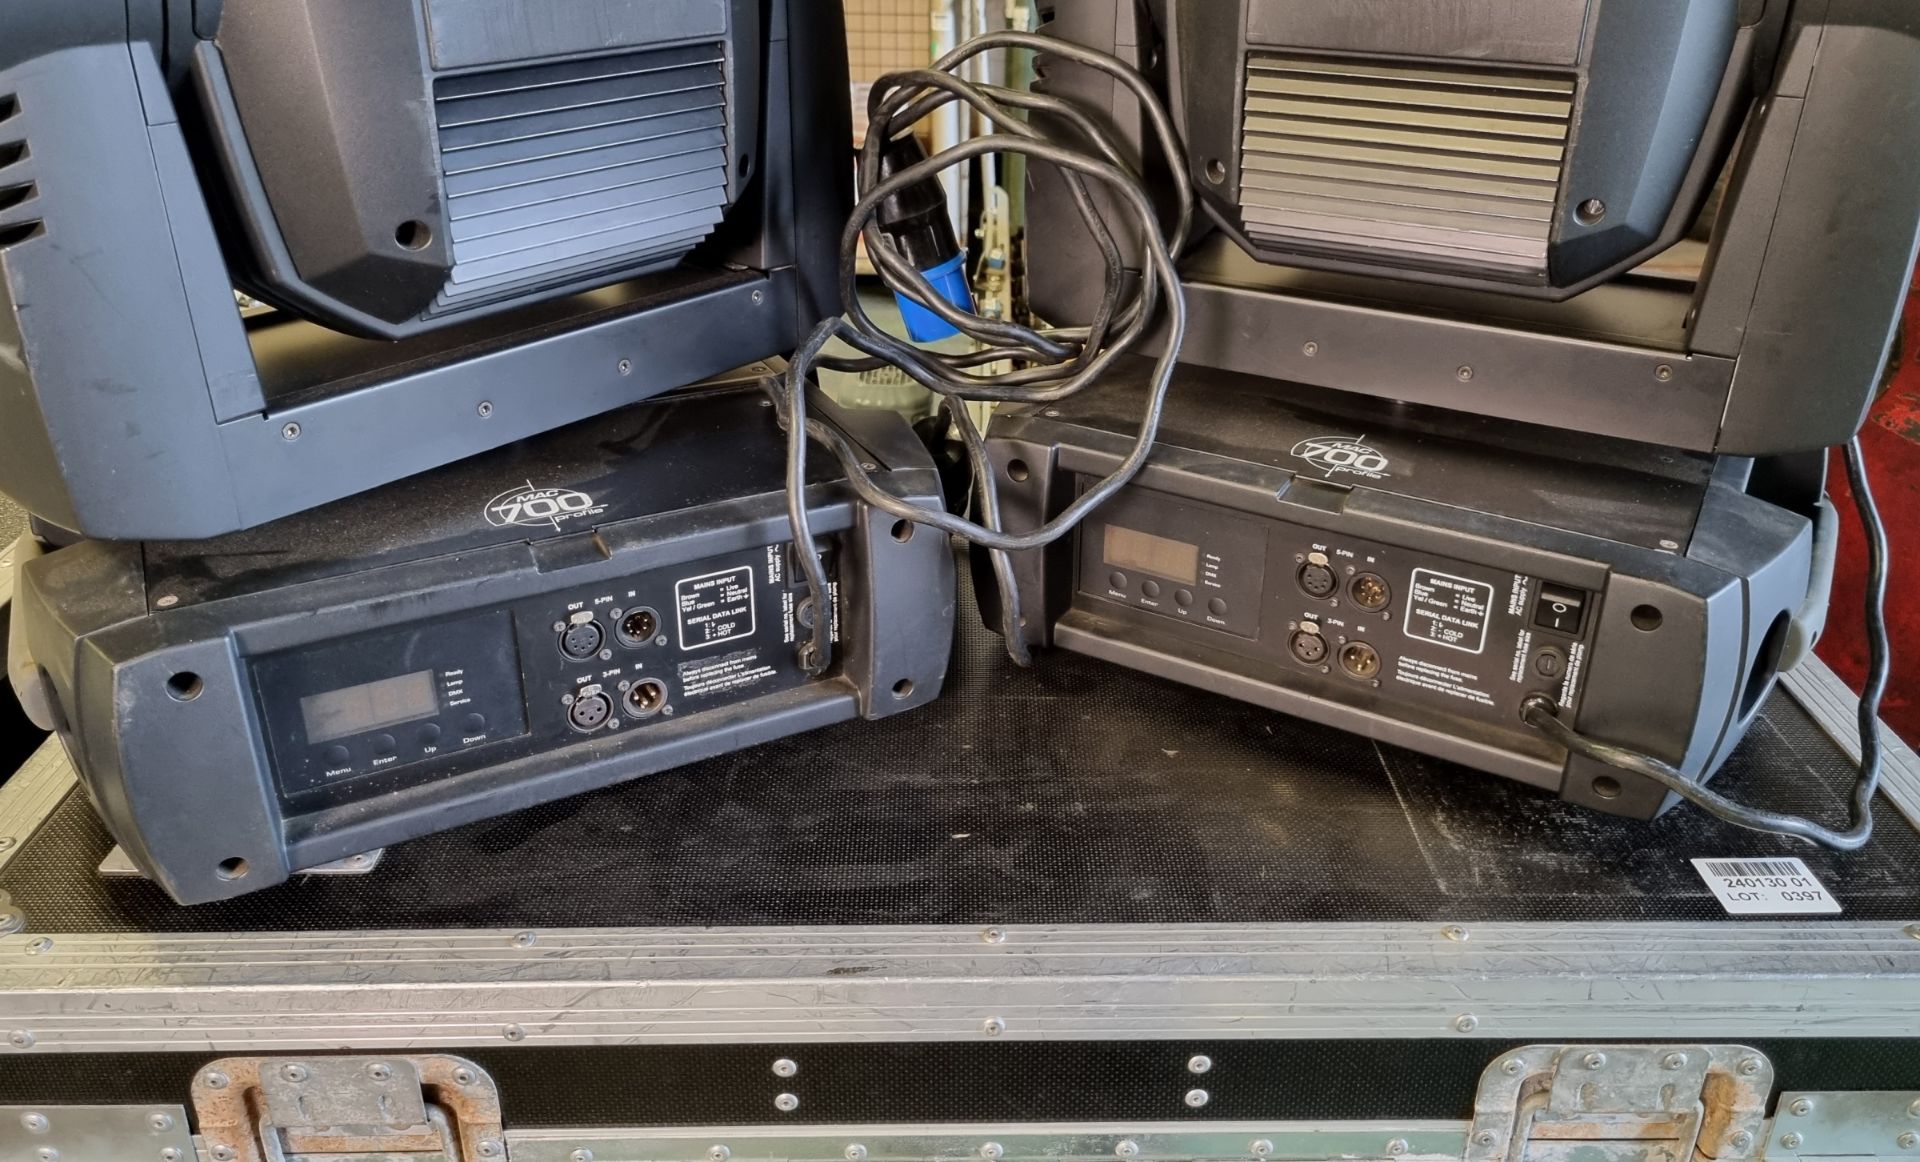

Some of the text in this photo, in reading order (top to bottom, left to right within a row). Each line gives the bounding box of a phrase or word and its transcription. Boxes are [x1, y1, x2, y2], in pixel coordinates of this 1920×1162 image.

[1331, 442, 1373, 454] MAC
[1300, 442, 1388, 471] 700
[1335, 467, 1382, 479] profile
[517, 490, 558, 502] MAC
[491, 492, 593, 523] 700
[554, 508, 604, 522] profile
[1312, 543, 1327, 551] OUT
[1336, 549, 1354, 558] 5-PIN
[693, 575, 736, 590] MAINS INPUT
[775, 573, 781, 582] AC
[1430, 578, 1476, 594] MAINS INPUT
[726, 587, 748, 597] Neutral
[1108, 590, 1126, 599] Menu
[1415, 583, 1435, 592] Brown
[1462, 594, 1476, 602] Live
[1508, 574, 1522, 615] MAINS INPUT
[568, 601, 584, 610] OUT
[697, 601, 715, 609] Green
[727, 594, 743, 603] Earth
[1141, 598, 1159, 607] Enter
[1428, 598, 1448, 608] Green
[1460, 606, 1476, 615] Earth
[1461, 600, 1484, 610] Neutral
[1515, 587, 1528, 616] AC supply
[687, 606, 747, 625] SERIAL DATA LINK
[1207, 615, 1225, 625] Down
[1304, 612, 1319, 620] OUT
[1416, 608, 1479, 629] SERIAL DATA LINK
[717, 622, 735, 631] COLD
[717, 629, 731, 637] HOT
[1442, 634, 1457, 642] HOT
[1444, 629, 1463, 638] COLD
[1399, 655, 1418, 664] Always
[445, 669, 463, 677] Ready
[682, 669, 701, 677] Always
[447, 679, 463, 687] Lamp
[576, 675, 592, 684] OUT
[448, 689, 463, 697] DMX
[450, 698, 471, 706] Service
[463, 734, 486, 744] Down
[373, 756, 397, 766] Enter
[326, 766, 352, 777] Menu
[1723, 877, 1812, 888] 240130 01
[1727, 891, 1822, 901] LOT: 0397
